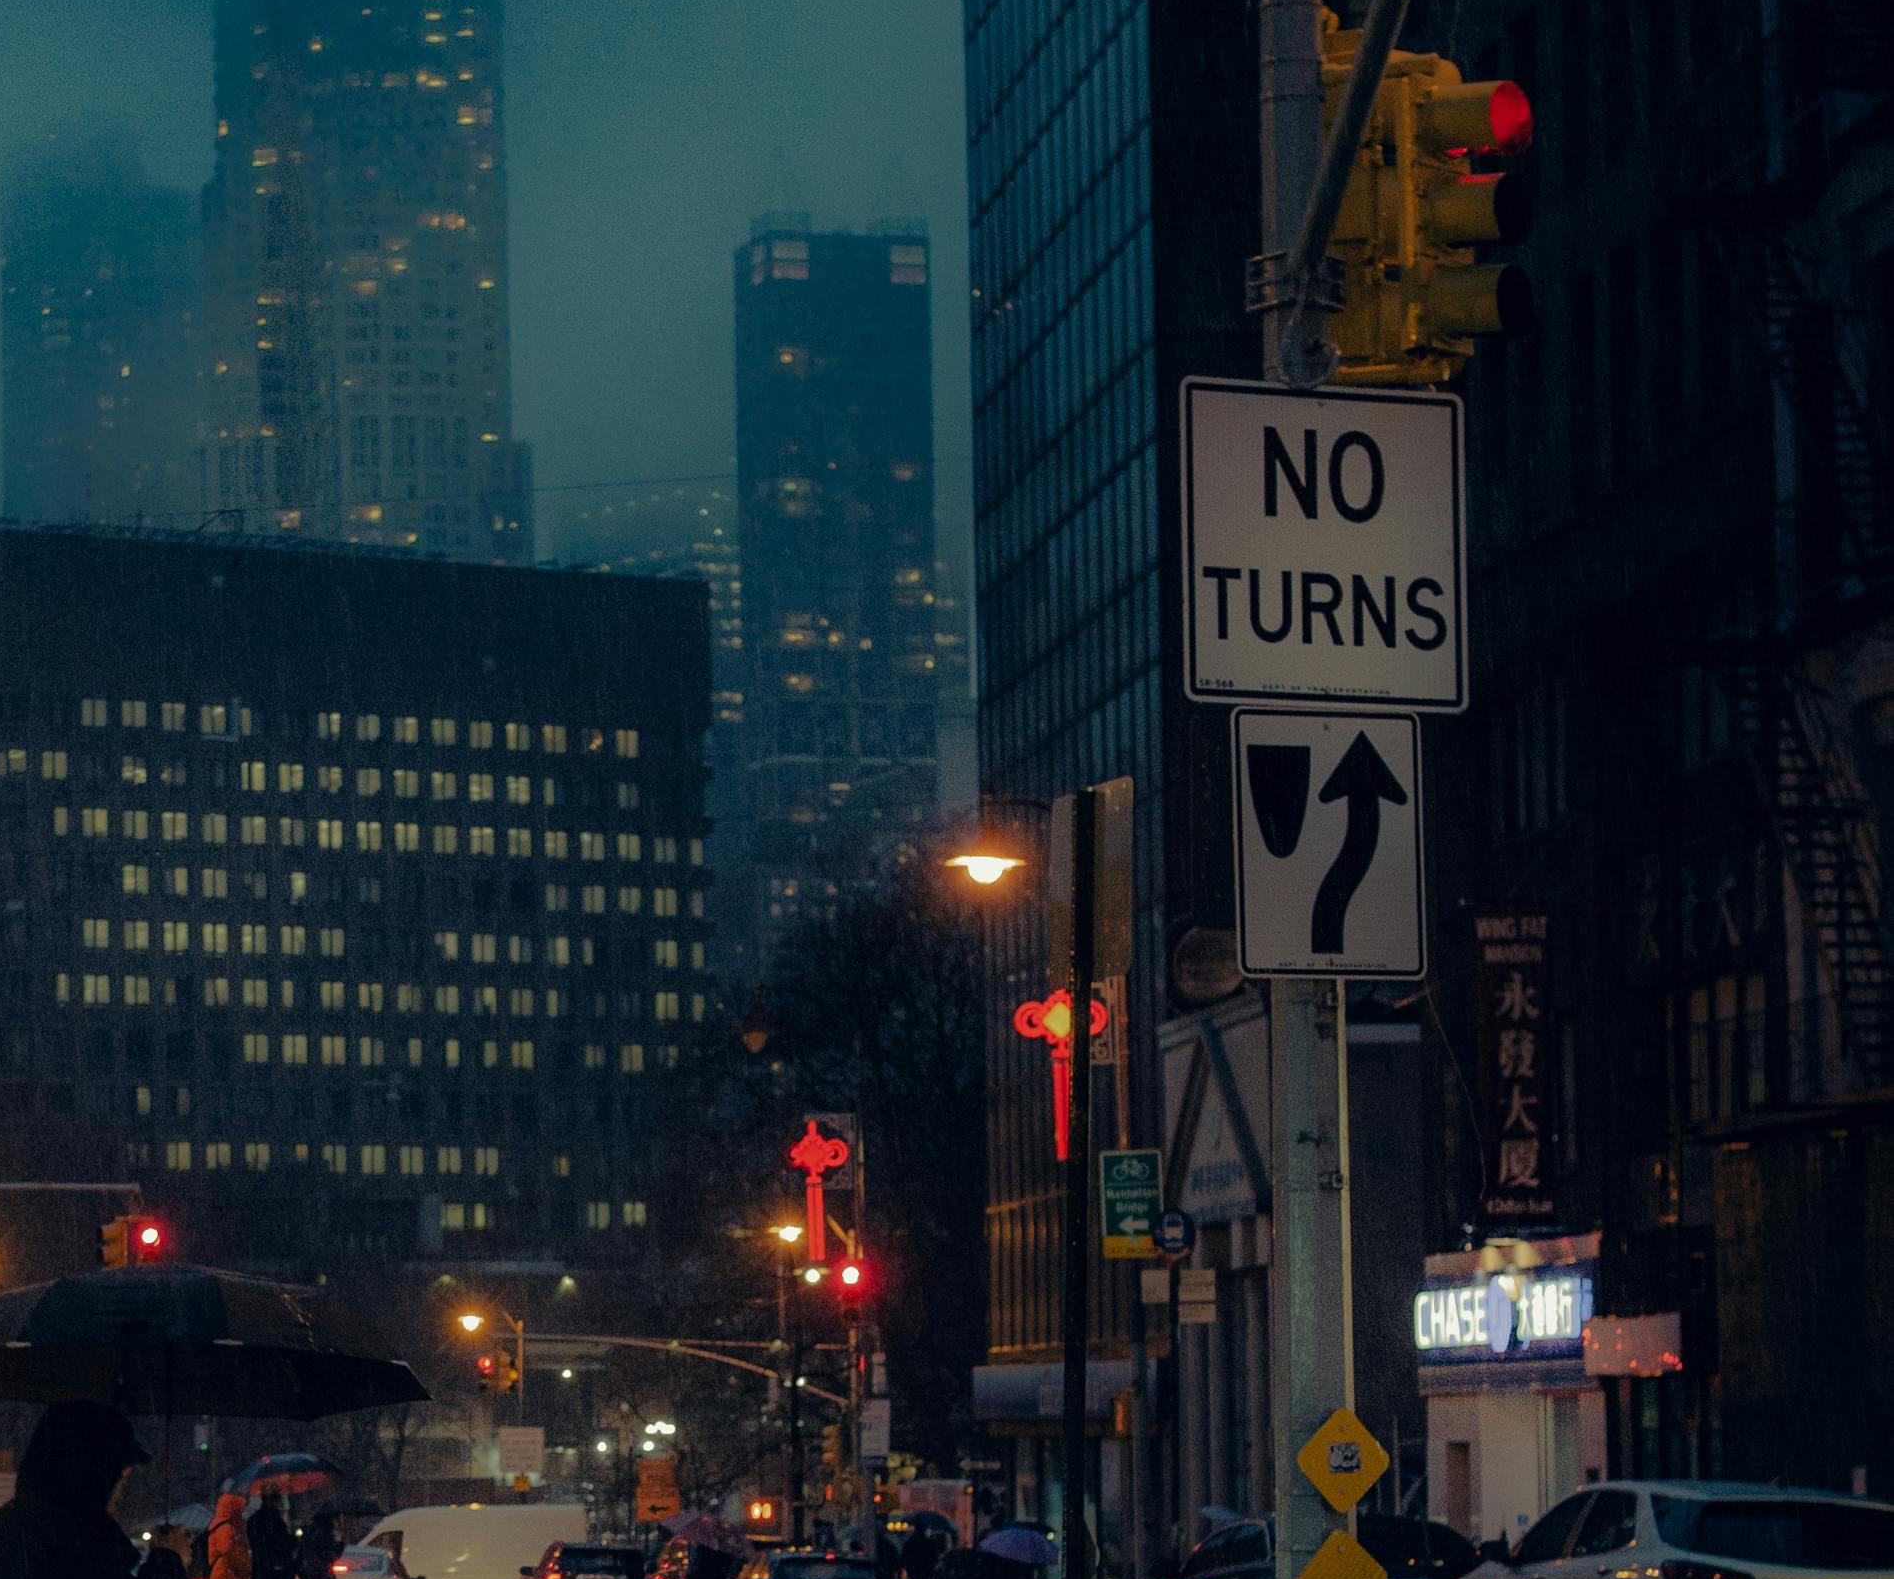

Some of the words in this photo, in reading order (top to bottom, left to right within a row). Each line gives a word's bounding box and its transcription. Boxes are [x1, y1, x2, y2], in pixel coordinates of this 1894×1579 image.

[1262, 425, 1386, 524] NO
[1202, 566, 1448, 652] TURNS
[1306, 686, 1391, 695] TRASPORTATION
[1415, 1288, 1488, 1350] CHASE
